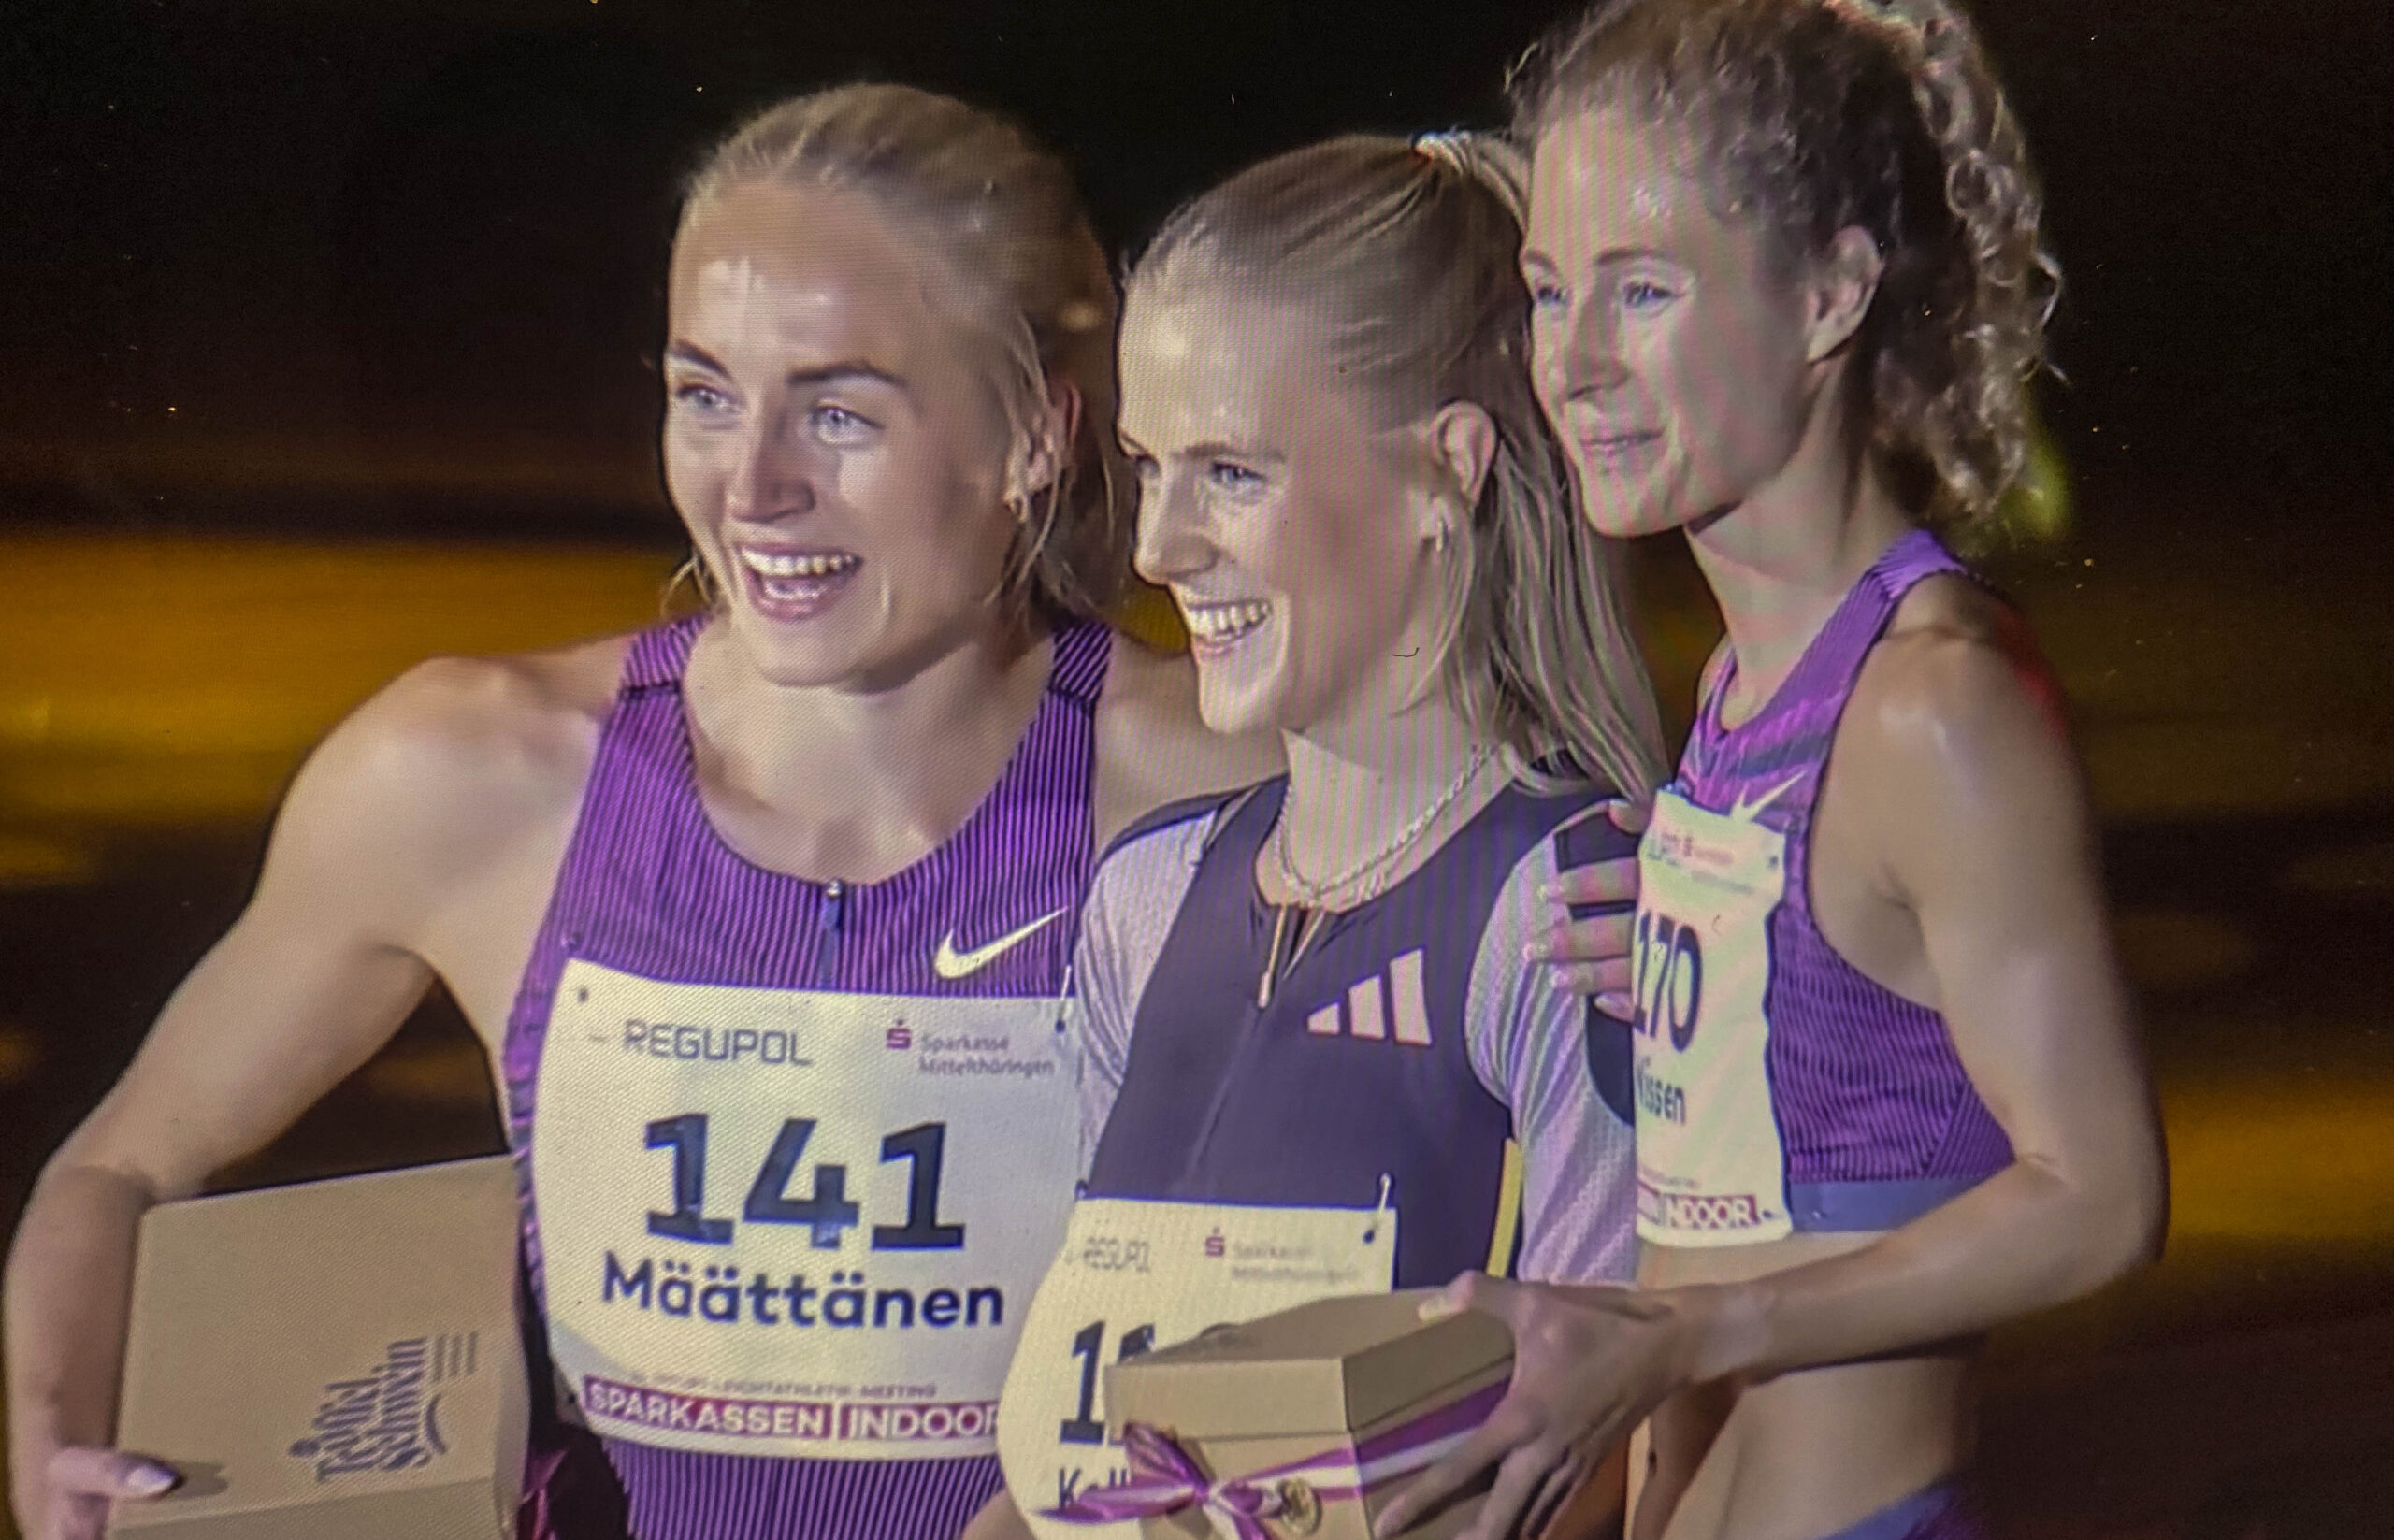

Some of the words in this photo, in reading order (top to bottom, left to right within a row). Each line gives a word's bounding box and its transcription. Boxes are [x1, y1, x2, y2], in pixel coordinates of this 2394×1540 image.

[623, 1017, 814, 1067] REGUPOL
[645, 1113, 966, 1251] 141
[600, 1250, 1005, 1328] Määttänen
[589, 1382, 823, 1436] SPARKASSEN
